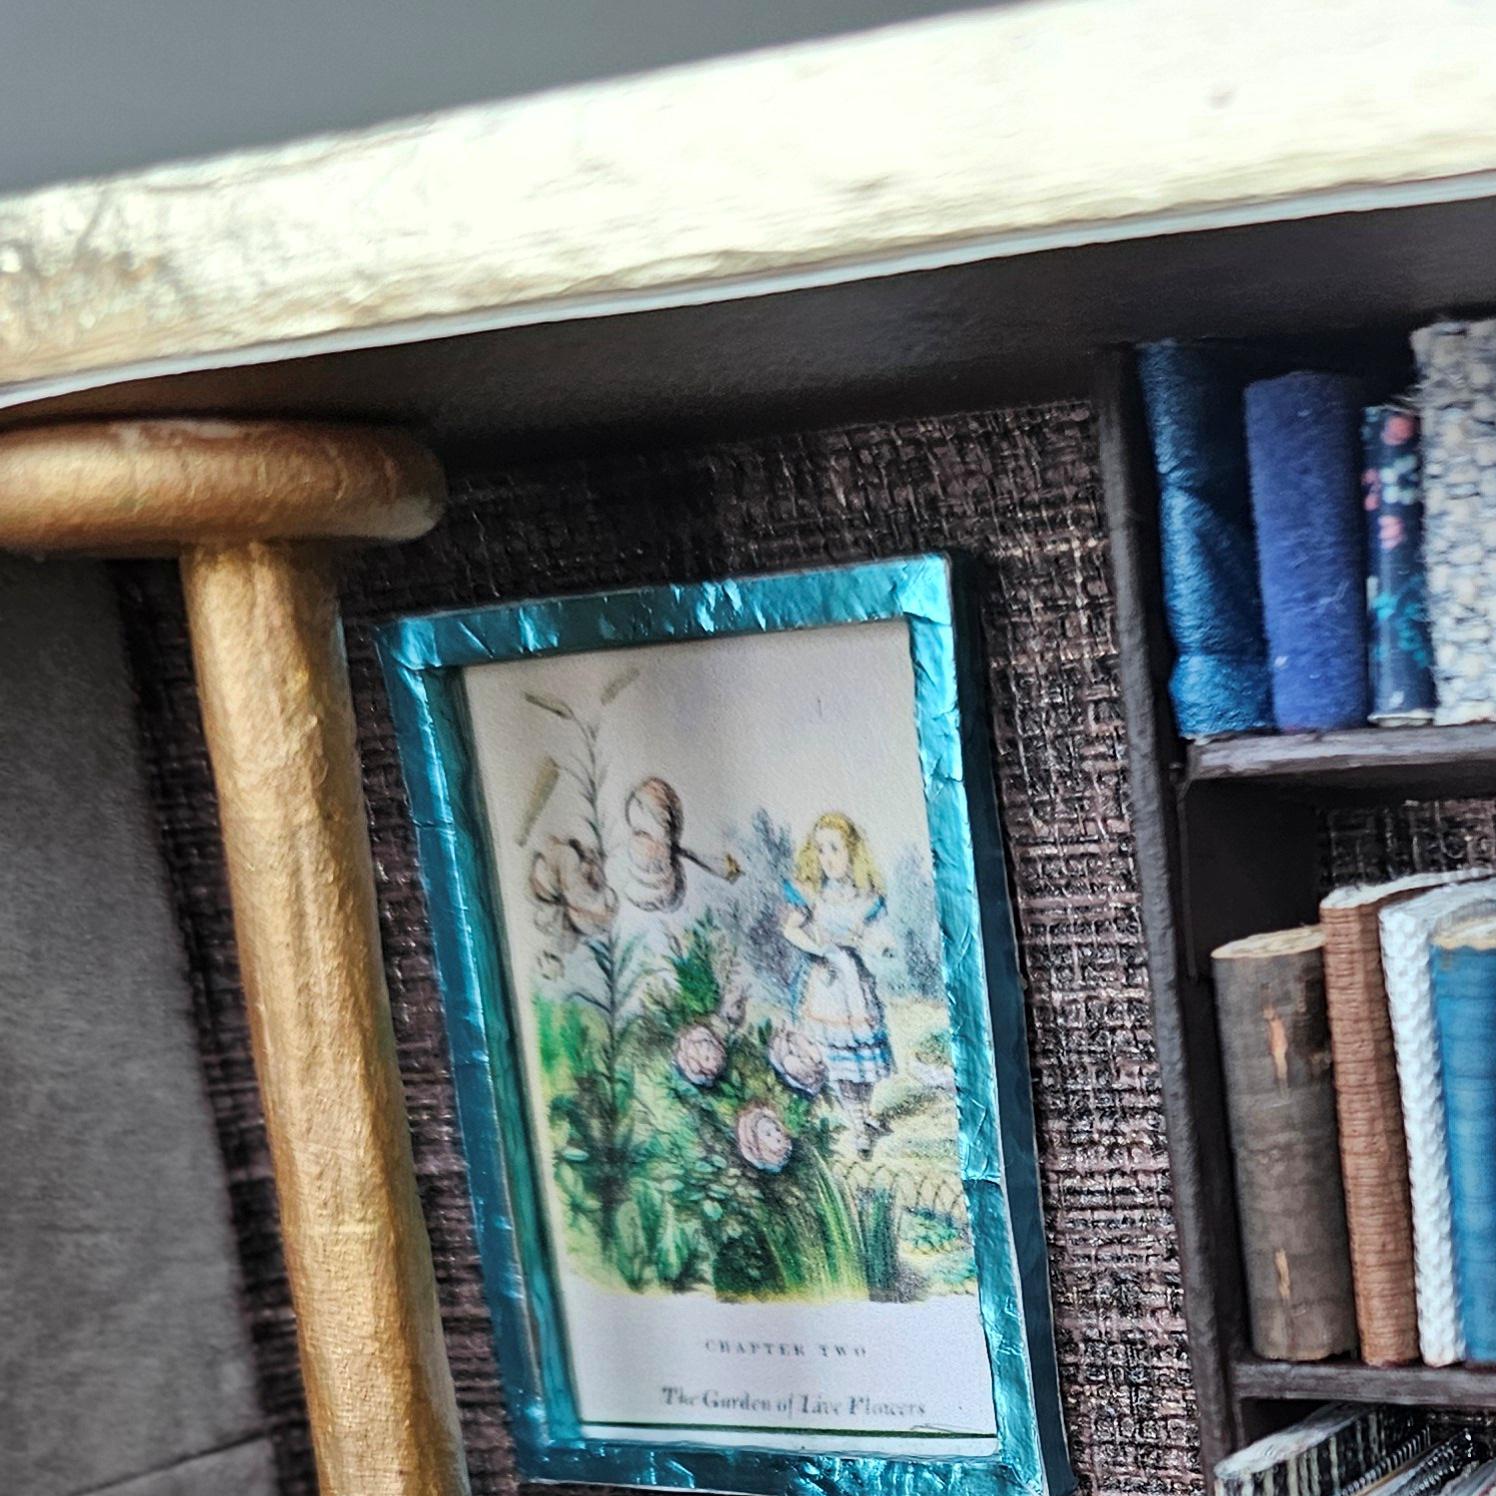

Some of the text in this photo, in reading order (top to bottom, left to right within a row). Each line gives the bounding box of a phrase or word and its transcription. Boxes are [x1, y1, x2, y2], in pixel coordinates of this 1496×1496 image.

[705, 1339, 867, 1358] CHAPTER TWO
[661, 1386, 926, 1418] The Garden of Live Flowers
